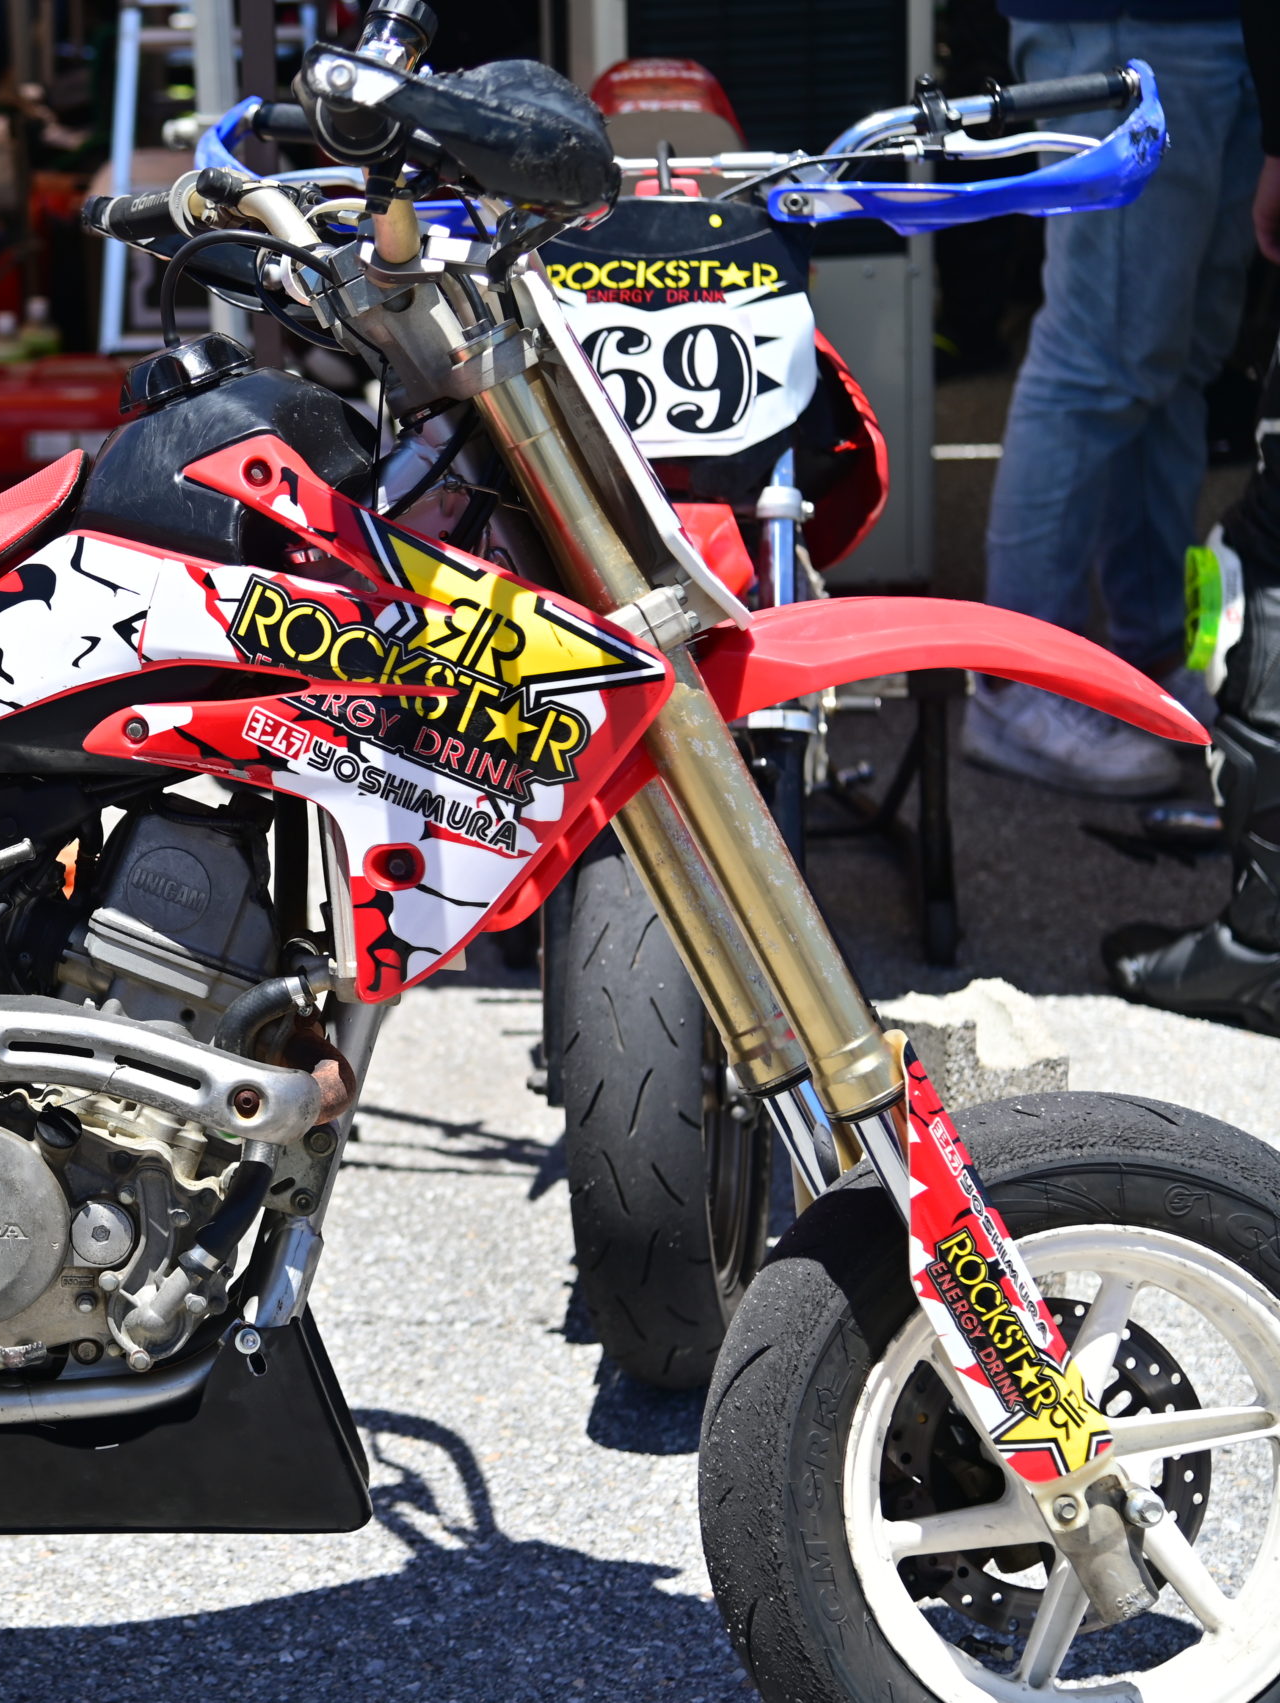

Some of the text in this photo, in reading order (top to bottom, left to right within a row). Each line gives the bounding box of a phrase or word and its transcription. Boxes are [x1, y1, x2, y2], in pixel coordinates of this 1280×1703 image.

[586, 289, 726, 304] ENERGY DRINK
[581, 324, 753, 434] 69
[307, 739, 519, 853] YOSHIMURA
[414, 726, 534, 797] DRINK
[132, 868, 206, 911] UNICAM
[959, 1173, 1049, 1344] YOSHIMURA
[930, 1261, 1024, 1409] ENERGY DRINK
